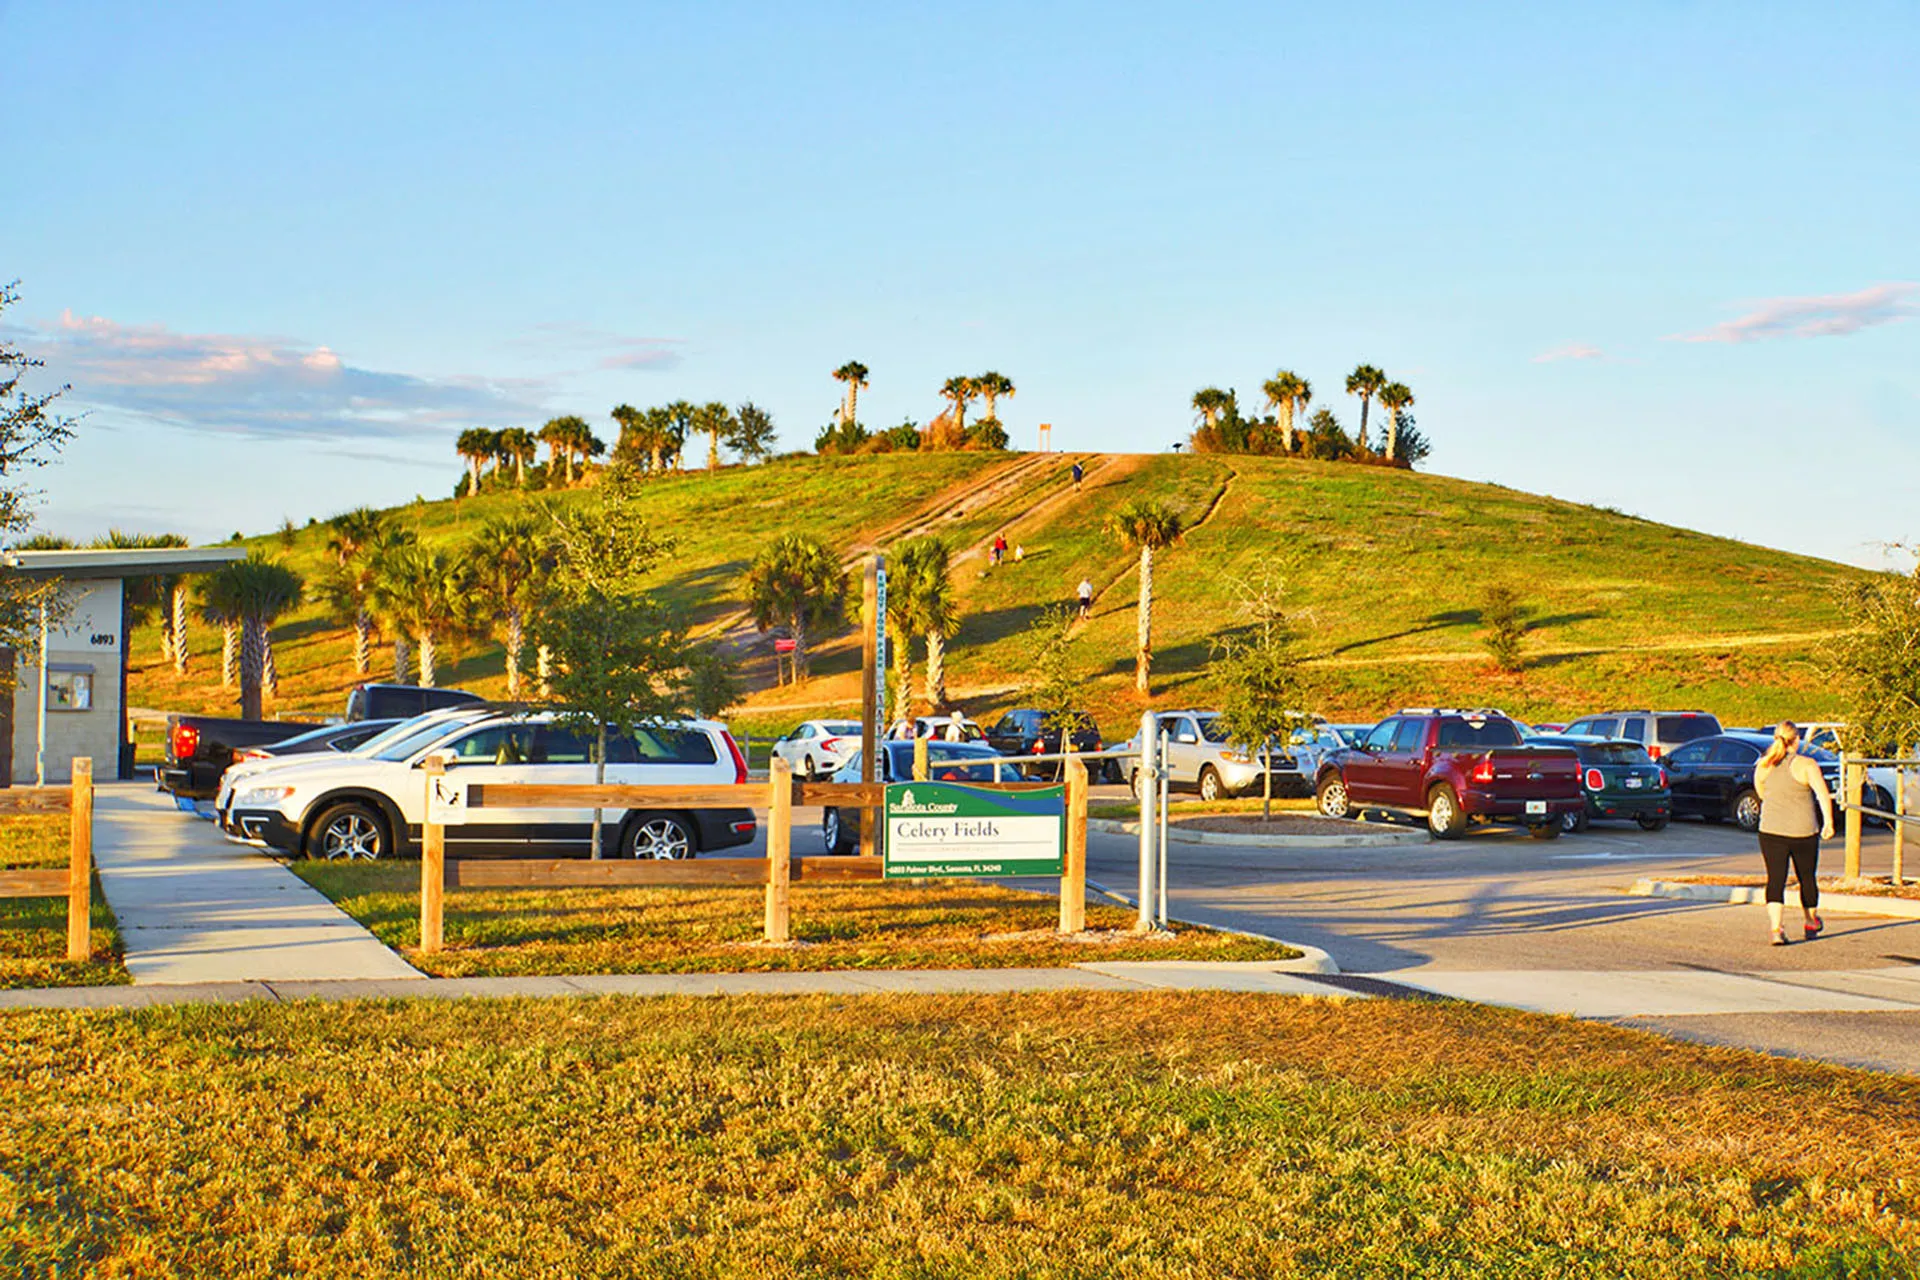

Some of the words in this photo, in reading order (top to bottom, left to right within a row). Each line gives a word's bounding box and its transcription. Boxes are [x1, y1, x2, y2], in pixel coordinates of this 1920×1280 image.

[90, 633, 115, 646] 6893
[927, 803, 958, 813] County
[897, 821, 949, 842] Celery
[954, 820, 1000, 837] Fields
